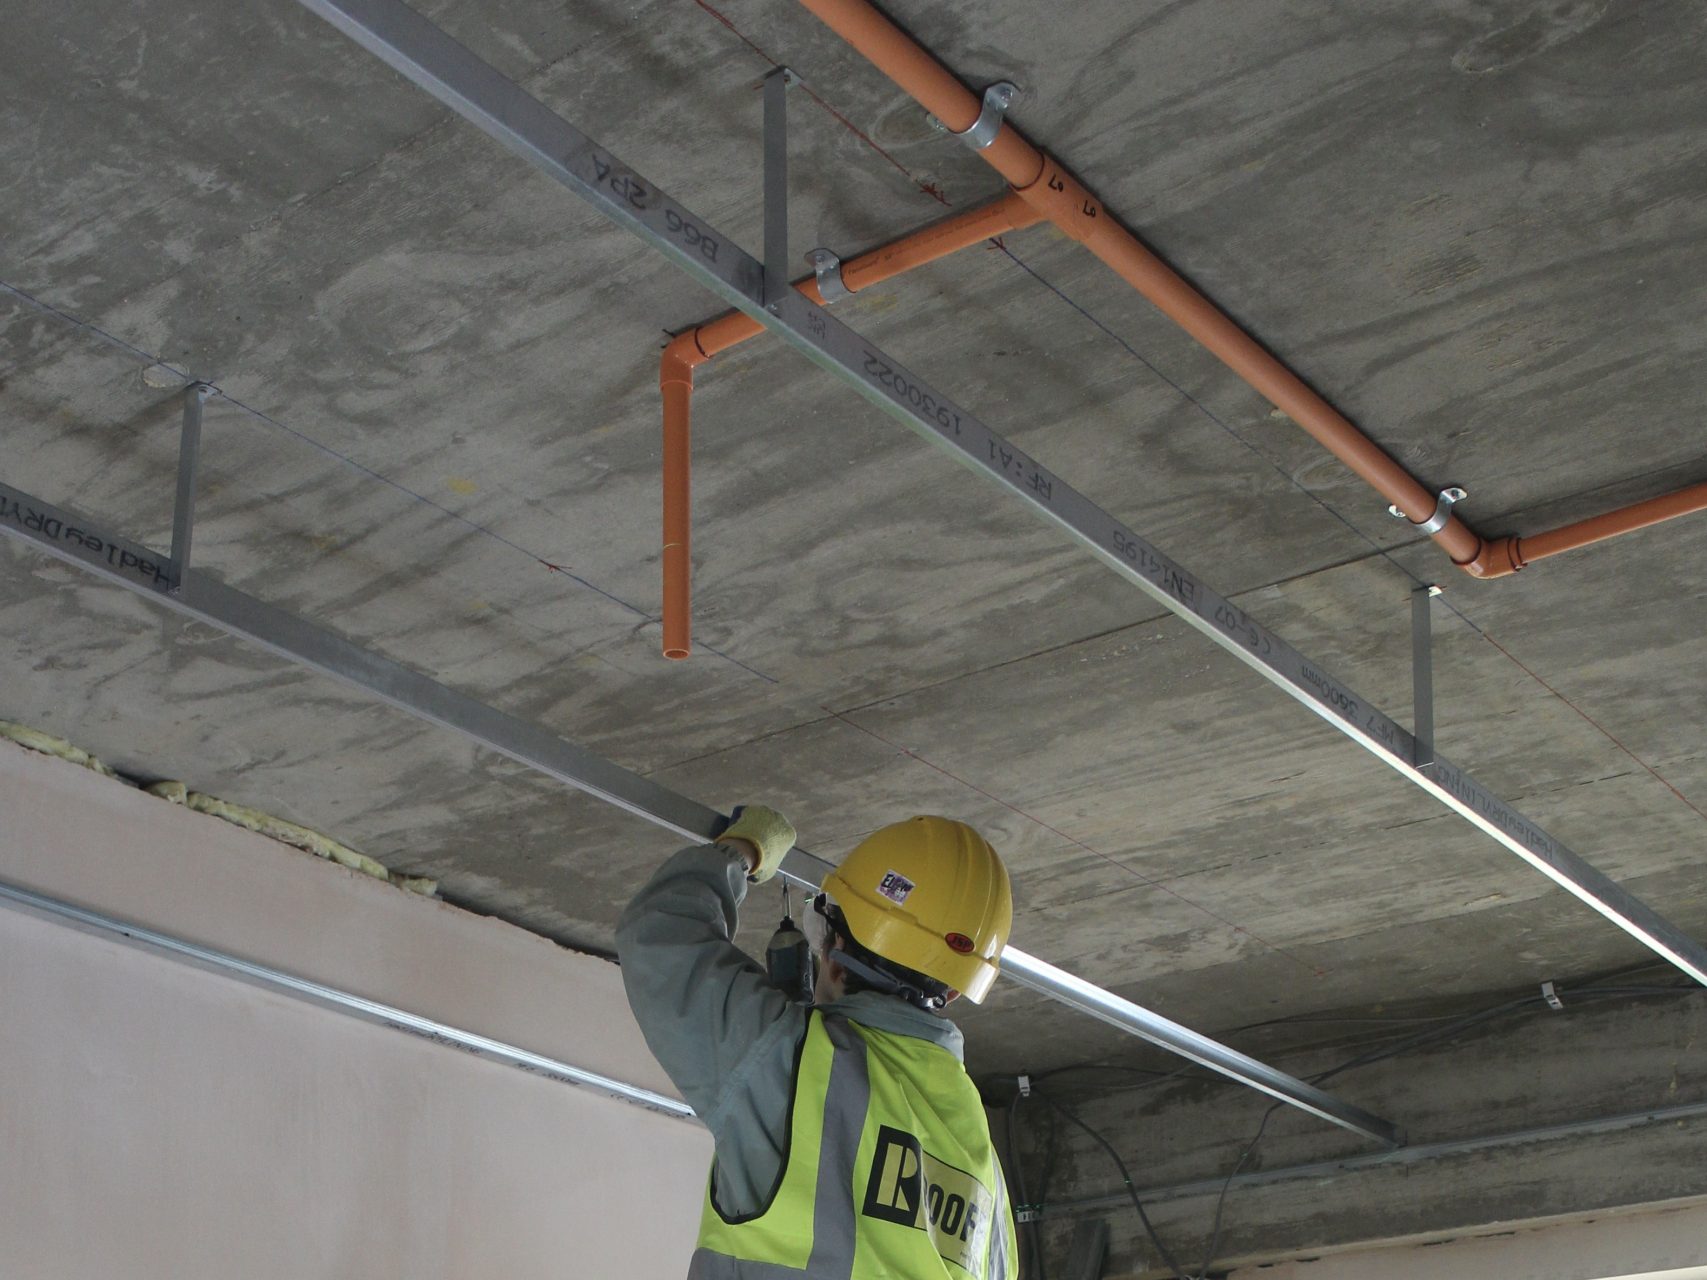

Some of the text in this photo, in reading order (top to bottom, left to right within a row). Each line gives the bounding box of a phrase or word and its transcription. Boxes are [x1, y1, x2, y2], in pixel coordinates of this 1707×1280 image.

[592, 153, 720, 263] B66 2PA
[862, 349, 963, 436] 1930022
[1112, 530, 1195, 600] EN14195
[1301, 665, 1359, 718] 3600mm
[1366, 718, 1395, 746] MF7
[924, 1175, 978, 1242] OOF
